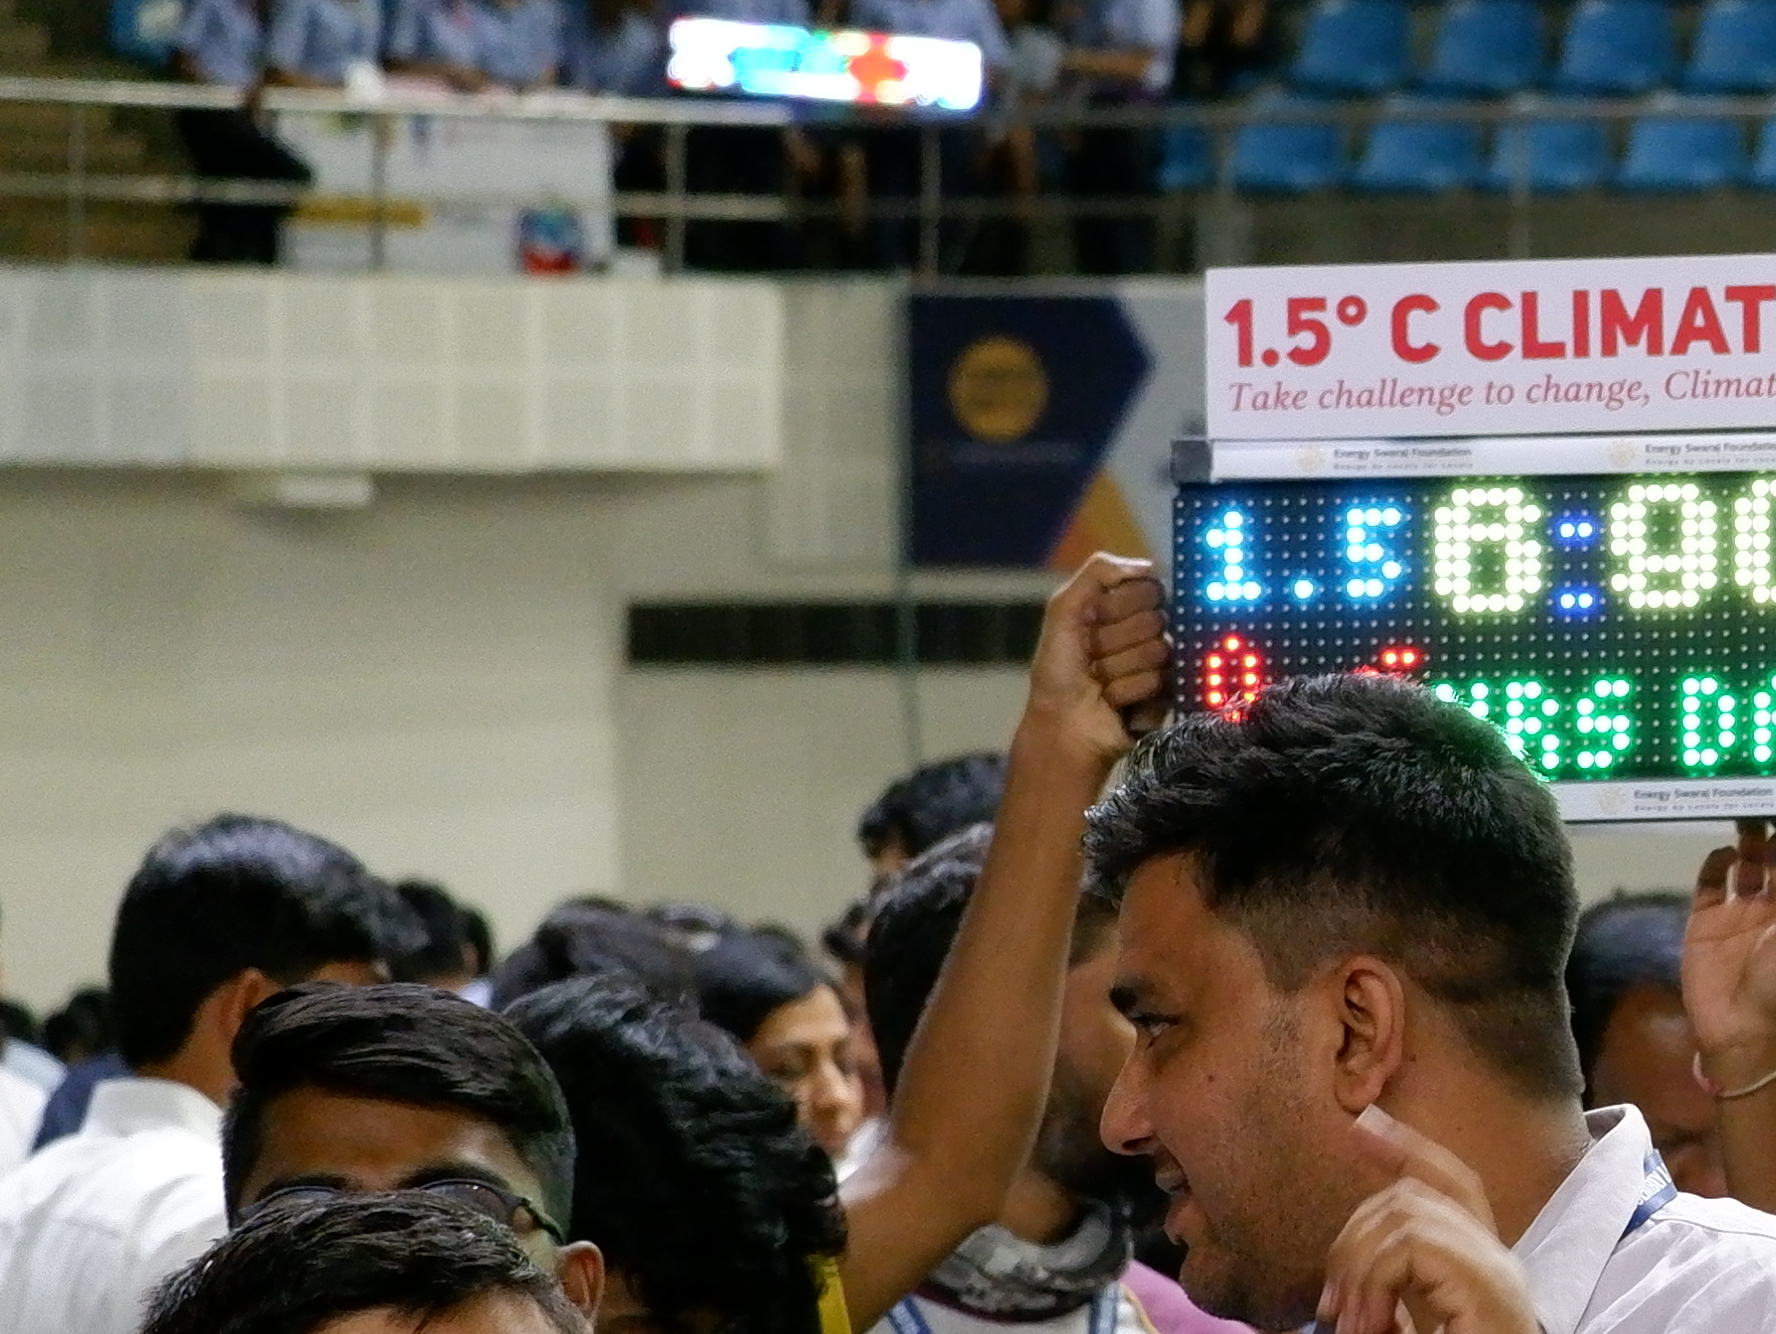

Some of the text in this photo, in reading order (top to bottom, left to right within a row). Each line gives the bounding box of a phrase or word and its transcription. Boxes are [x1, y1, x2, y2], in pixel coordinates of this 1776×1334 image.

[1391, 293, 1440, 364] C
[1229, 382, 1307, 413] Take
[1318, 378, 1474, 415] challenge
[1485, 382, 1515, 406] to
[1525, 374, 1651, 411] change,
